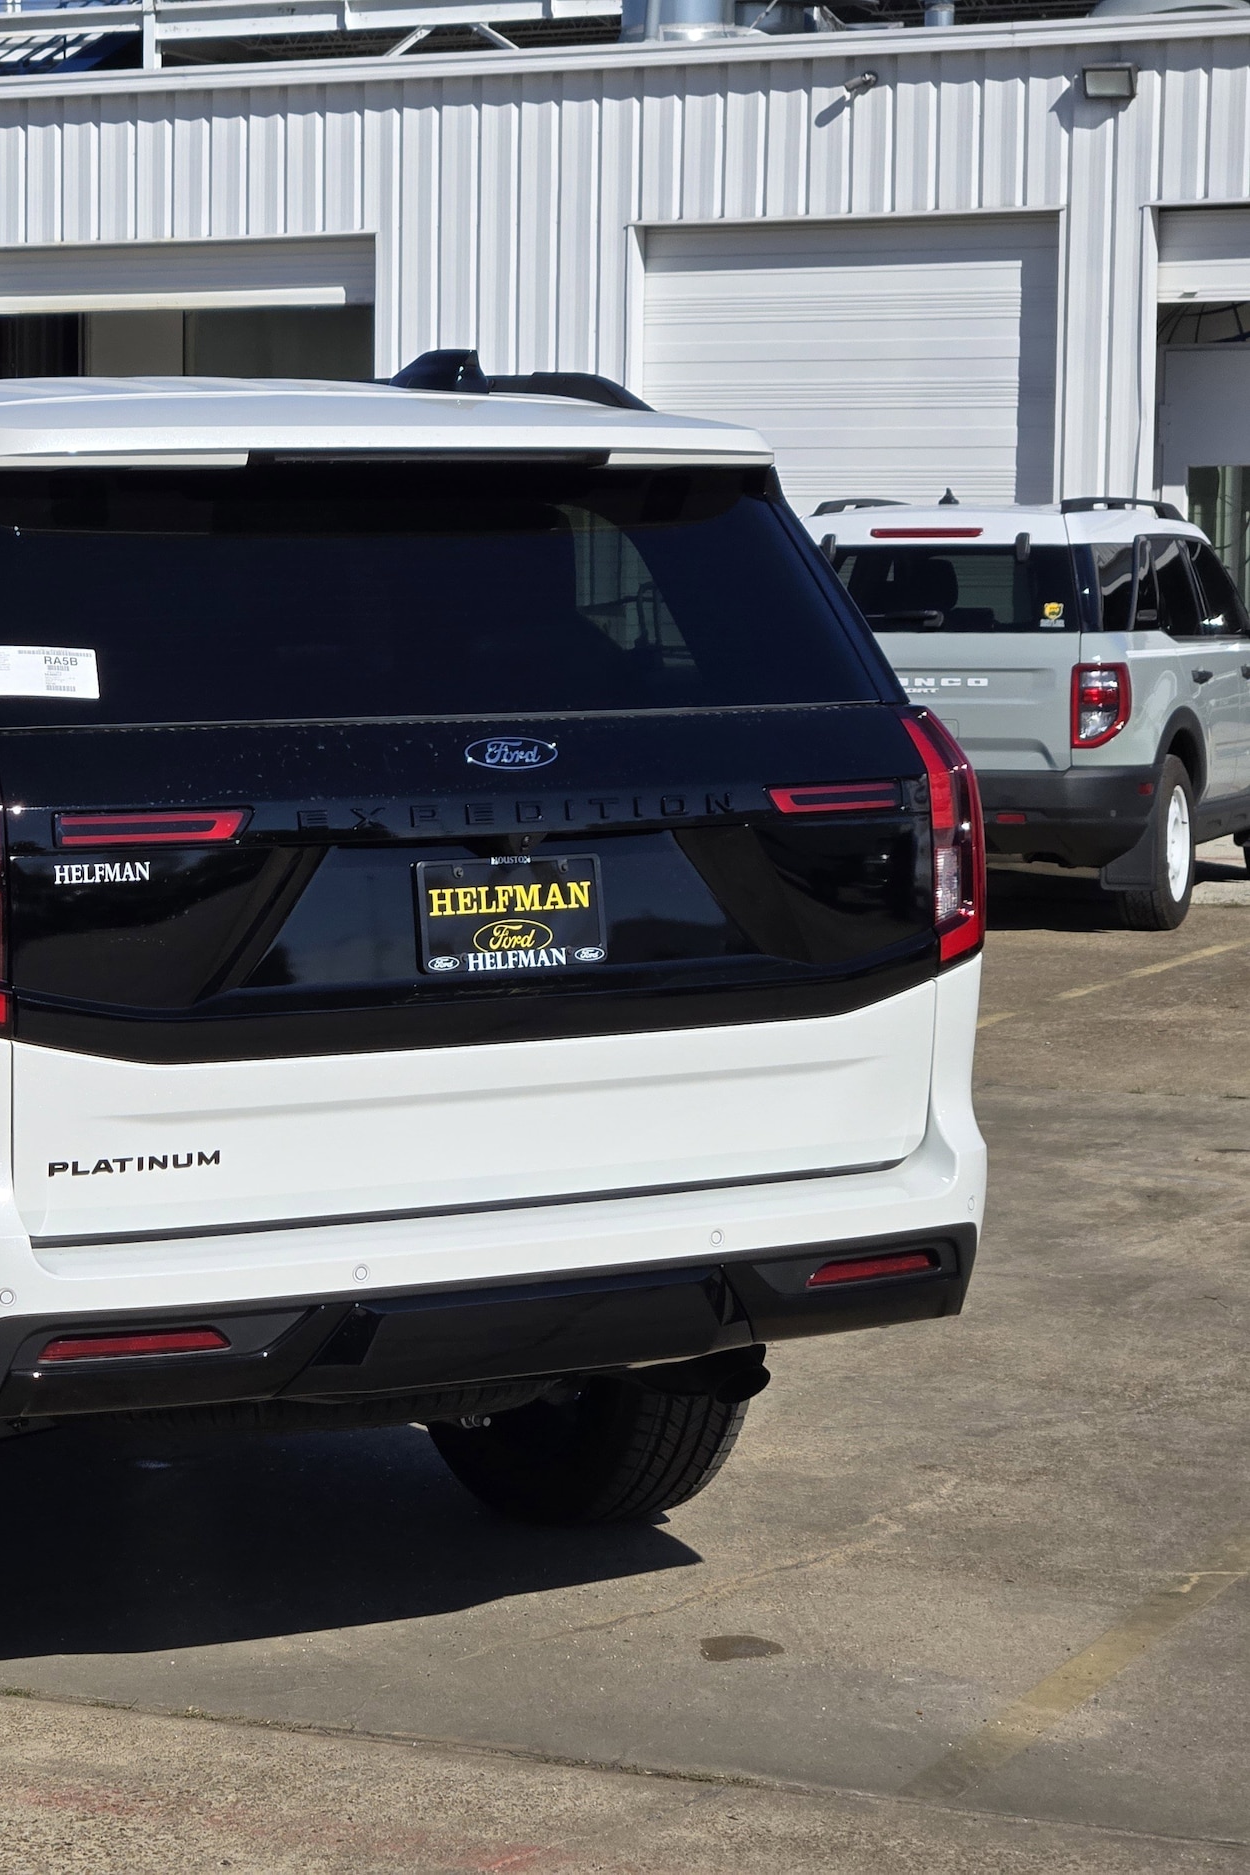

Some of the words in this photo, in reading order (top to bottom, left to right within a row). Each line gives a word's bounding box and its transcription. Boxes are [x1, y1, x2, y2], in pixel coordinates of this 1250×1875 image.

[44, 655, 79, 667] RA5B
[297, 791, 736, 832] EXPEDITION
[53, 861, 151, 885] HELFMAN
[490, 855, 531, 866] HOUSTON
[428, 880, 591, 917] HELFMAN
[488, 923, 537, 950] Ford
[467, 947, 568, 972] HELFMAN
[48, 1150, 221, 1178] PLATINUM
